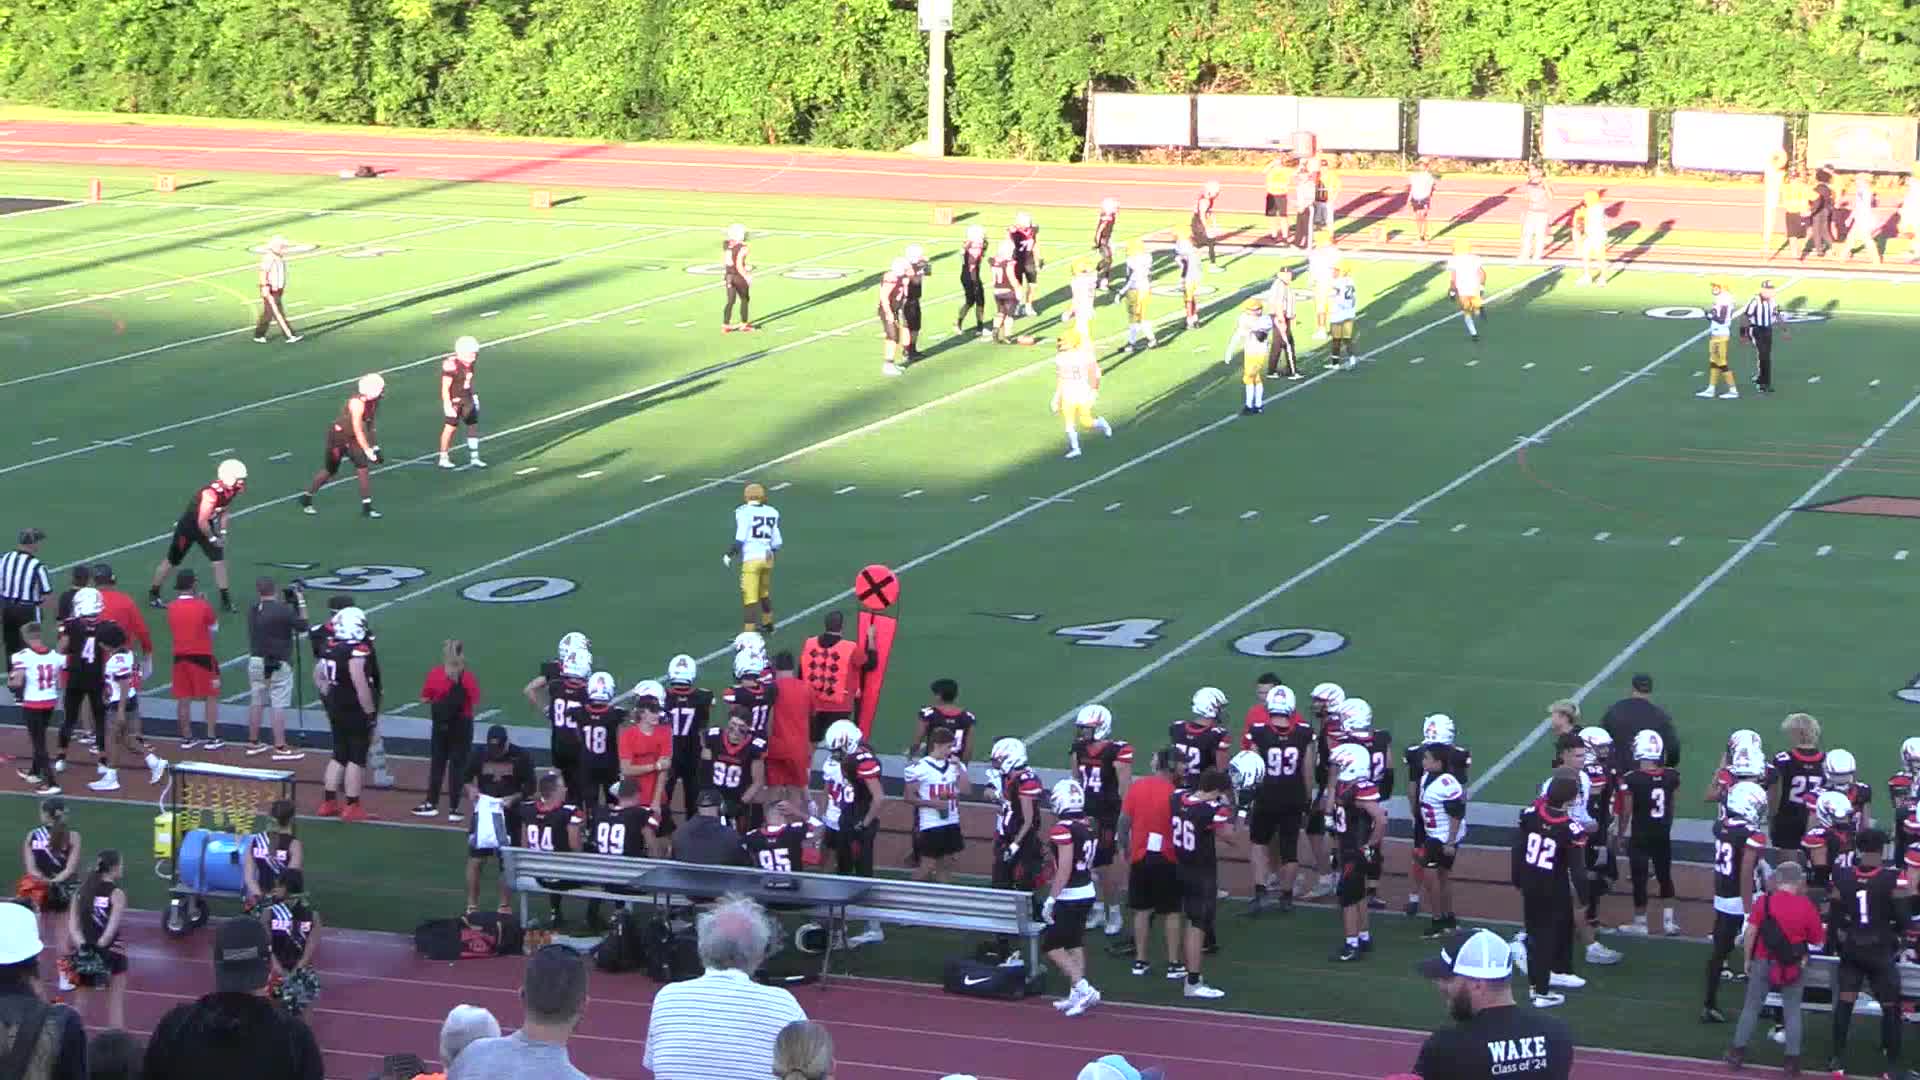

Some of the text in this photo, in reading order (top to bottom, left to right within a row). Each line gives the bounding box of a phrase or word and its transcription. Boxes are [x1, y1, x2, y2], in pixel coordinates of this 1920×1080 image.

[81, 637, 96, 664] 4
[670, 707, 696, 737] 17
[583, 725, 607, 755] 18
[1267, 747, 1300, 777] 93
[1651, 788, 1665, 819] 3
[526, 824, 554, 851] 94
[597, 822, 626, 855] 99
[1171, 816, 1196, 852] 26
[758, 848, 792, 873] 95
[1525, 832, 1558, 871] 92
[1856, 889, 1868, 924] 1
[1487, 1036, 1547, 1063] WAKE
[1491, 1061, 1517, 1076] Class
[1519, 1059, 1530, 1072] of
